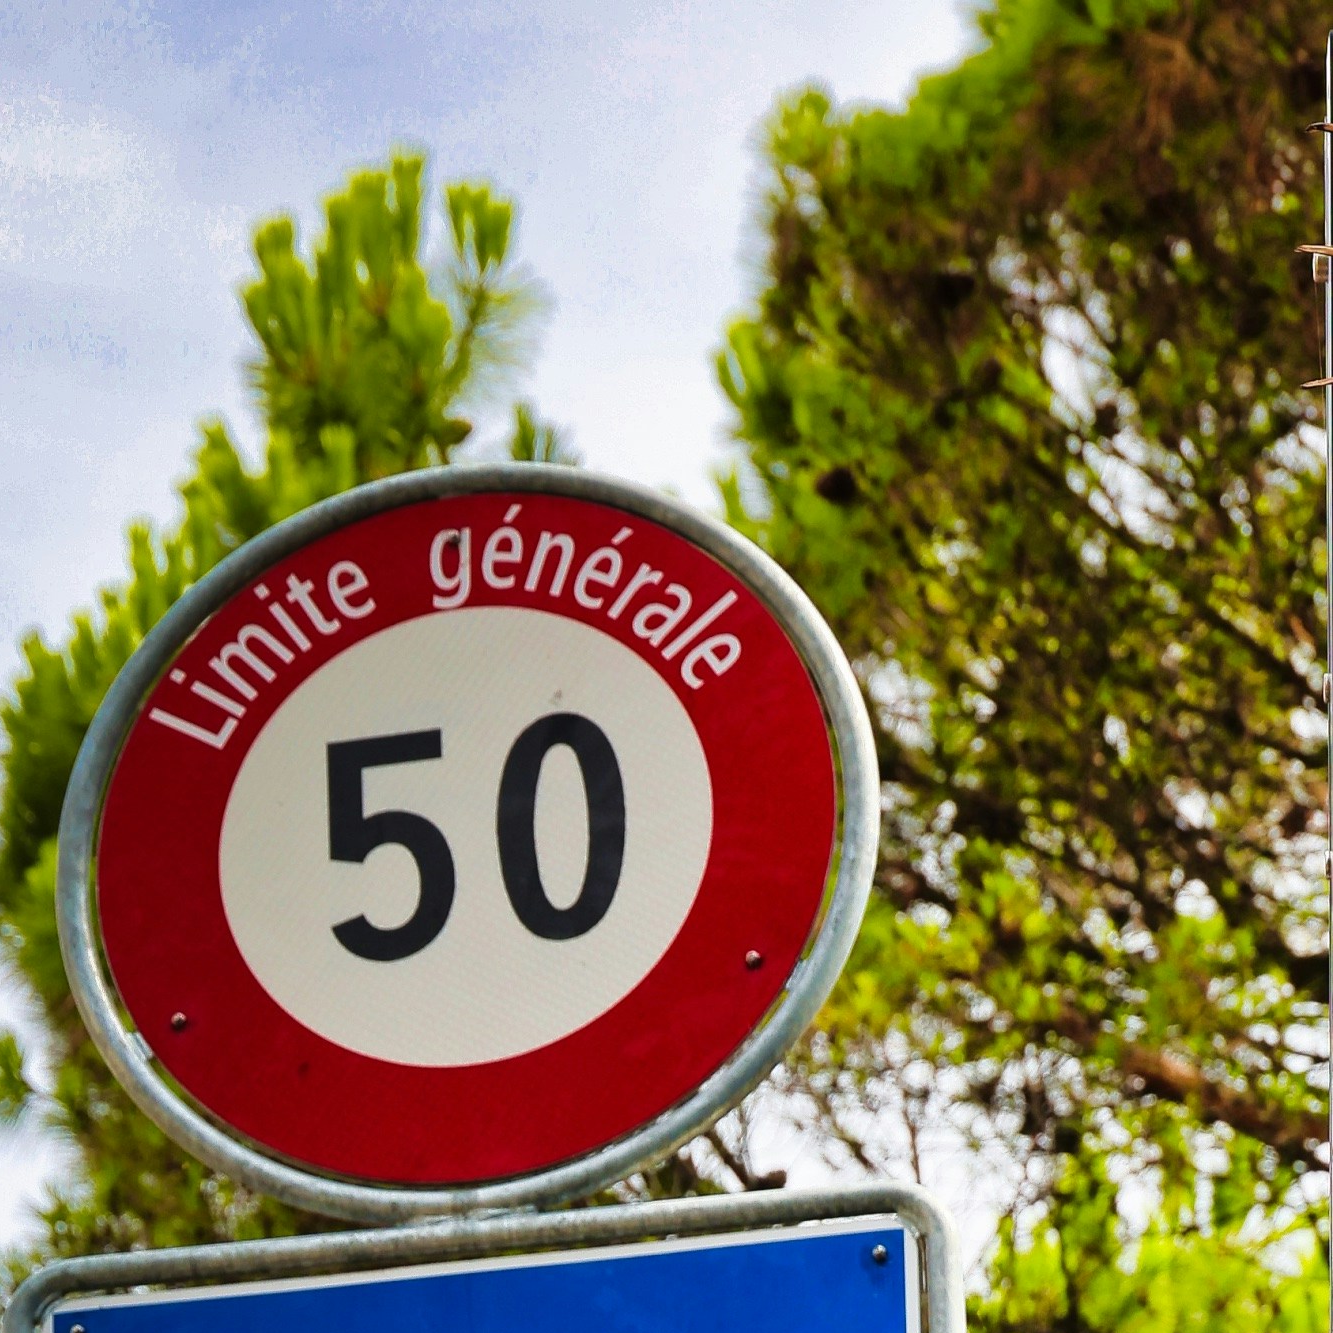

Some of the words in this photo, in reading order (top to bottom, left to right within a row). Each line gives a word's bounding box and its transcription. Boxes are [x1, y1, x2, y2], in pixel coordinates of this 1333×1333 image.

[149, 560, 377, 751] Limite
[429, 504, 741, 690] générale
[326, 711, 626, 962] 50
